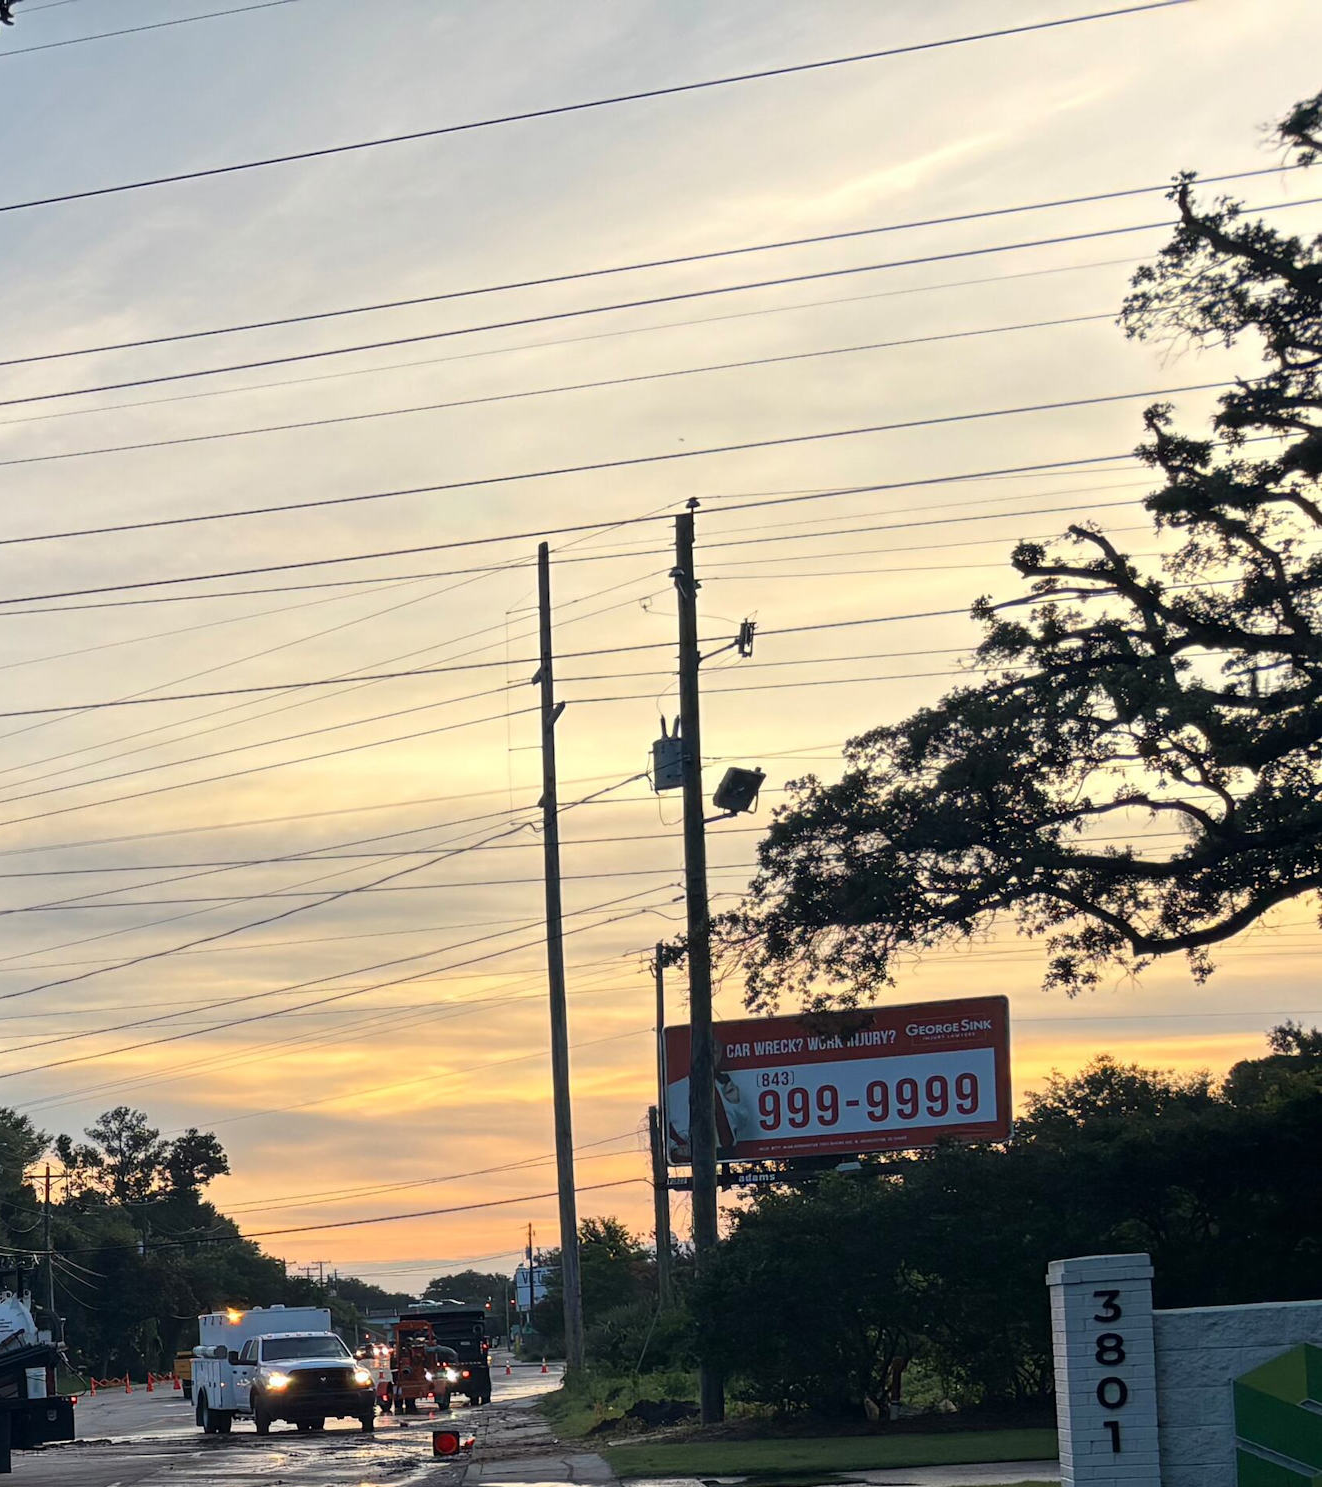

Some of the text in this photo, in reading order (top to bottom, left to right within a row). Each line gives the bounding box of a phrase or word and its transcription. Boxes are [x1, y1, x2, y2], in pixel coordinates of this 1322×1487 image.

[905, 1019, 992, 1036] GEORGE SINK
[726, 1042, 750, 1058] CAR
[754, 1037, 803, 1056] WRECK?
[757, 1071, 795, 1088] (843)
[758, 1073, 979, 1131] 999-9999
[738, 1173, 775, 1183] adams
[1093, 1290, 1128, 1453] 3801
